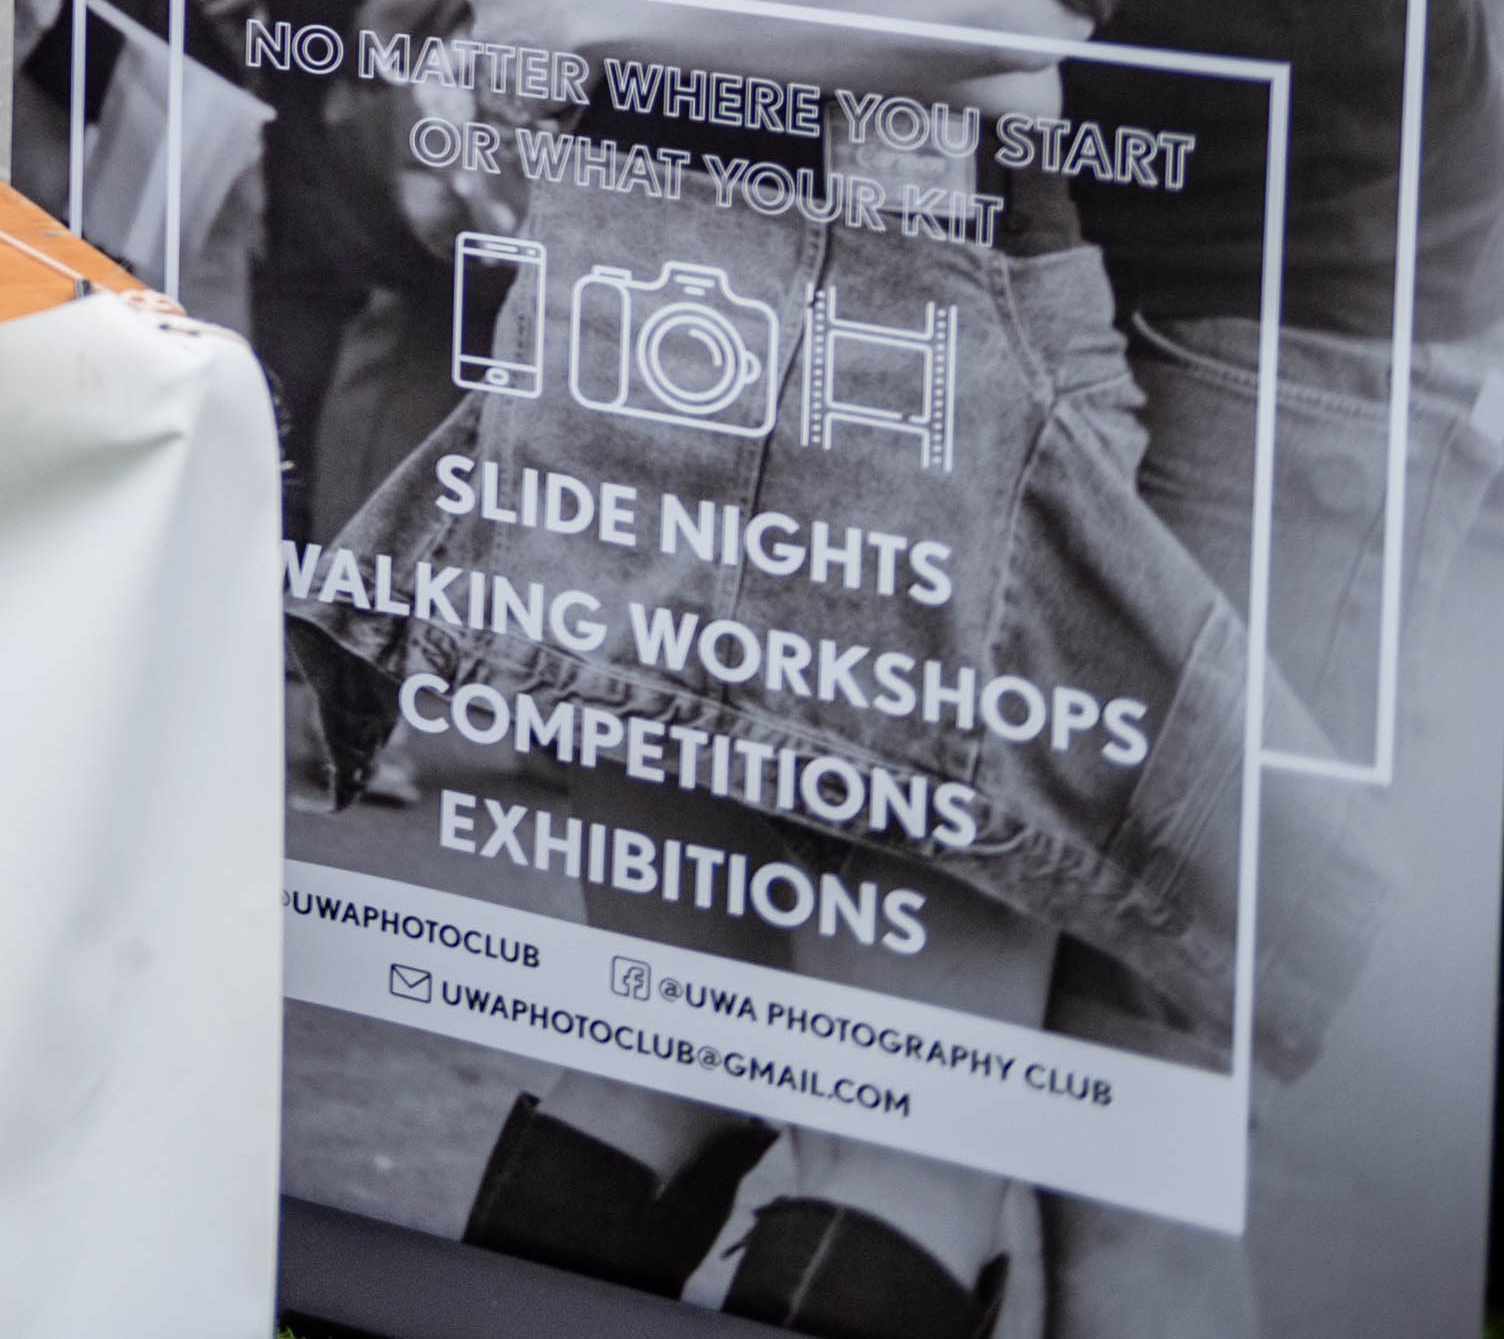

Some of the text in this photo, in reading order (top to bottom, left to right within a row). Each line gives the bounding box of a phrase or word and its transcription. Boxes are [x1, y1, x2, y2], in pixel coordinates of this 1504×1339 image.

[244, 19, 1196, 190] NO MATTER WHERE YOU START
[410, 117, 501, 173] OR
[516, 130, 692, 200] WHAT
[702, 156, 887, 233] YOUR
[899, 185, 1005, 248] KIT
[434, 454, 954, 607] SLIDE NIGHTS
[282, 538, 1151, 768] WALKING WORKSHOPS
[398, 671, 978, 851] COMPETITIONS
[439, 788, 930, 957] EXHIBITIONS
[441, 979, 911, 1118] UWAPHOTOCLUB@GMAIL.COM
[657, 976, 1113, 1108] @UWA PHOTOGRAPHY CLUB
